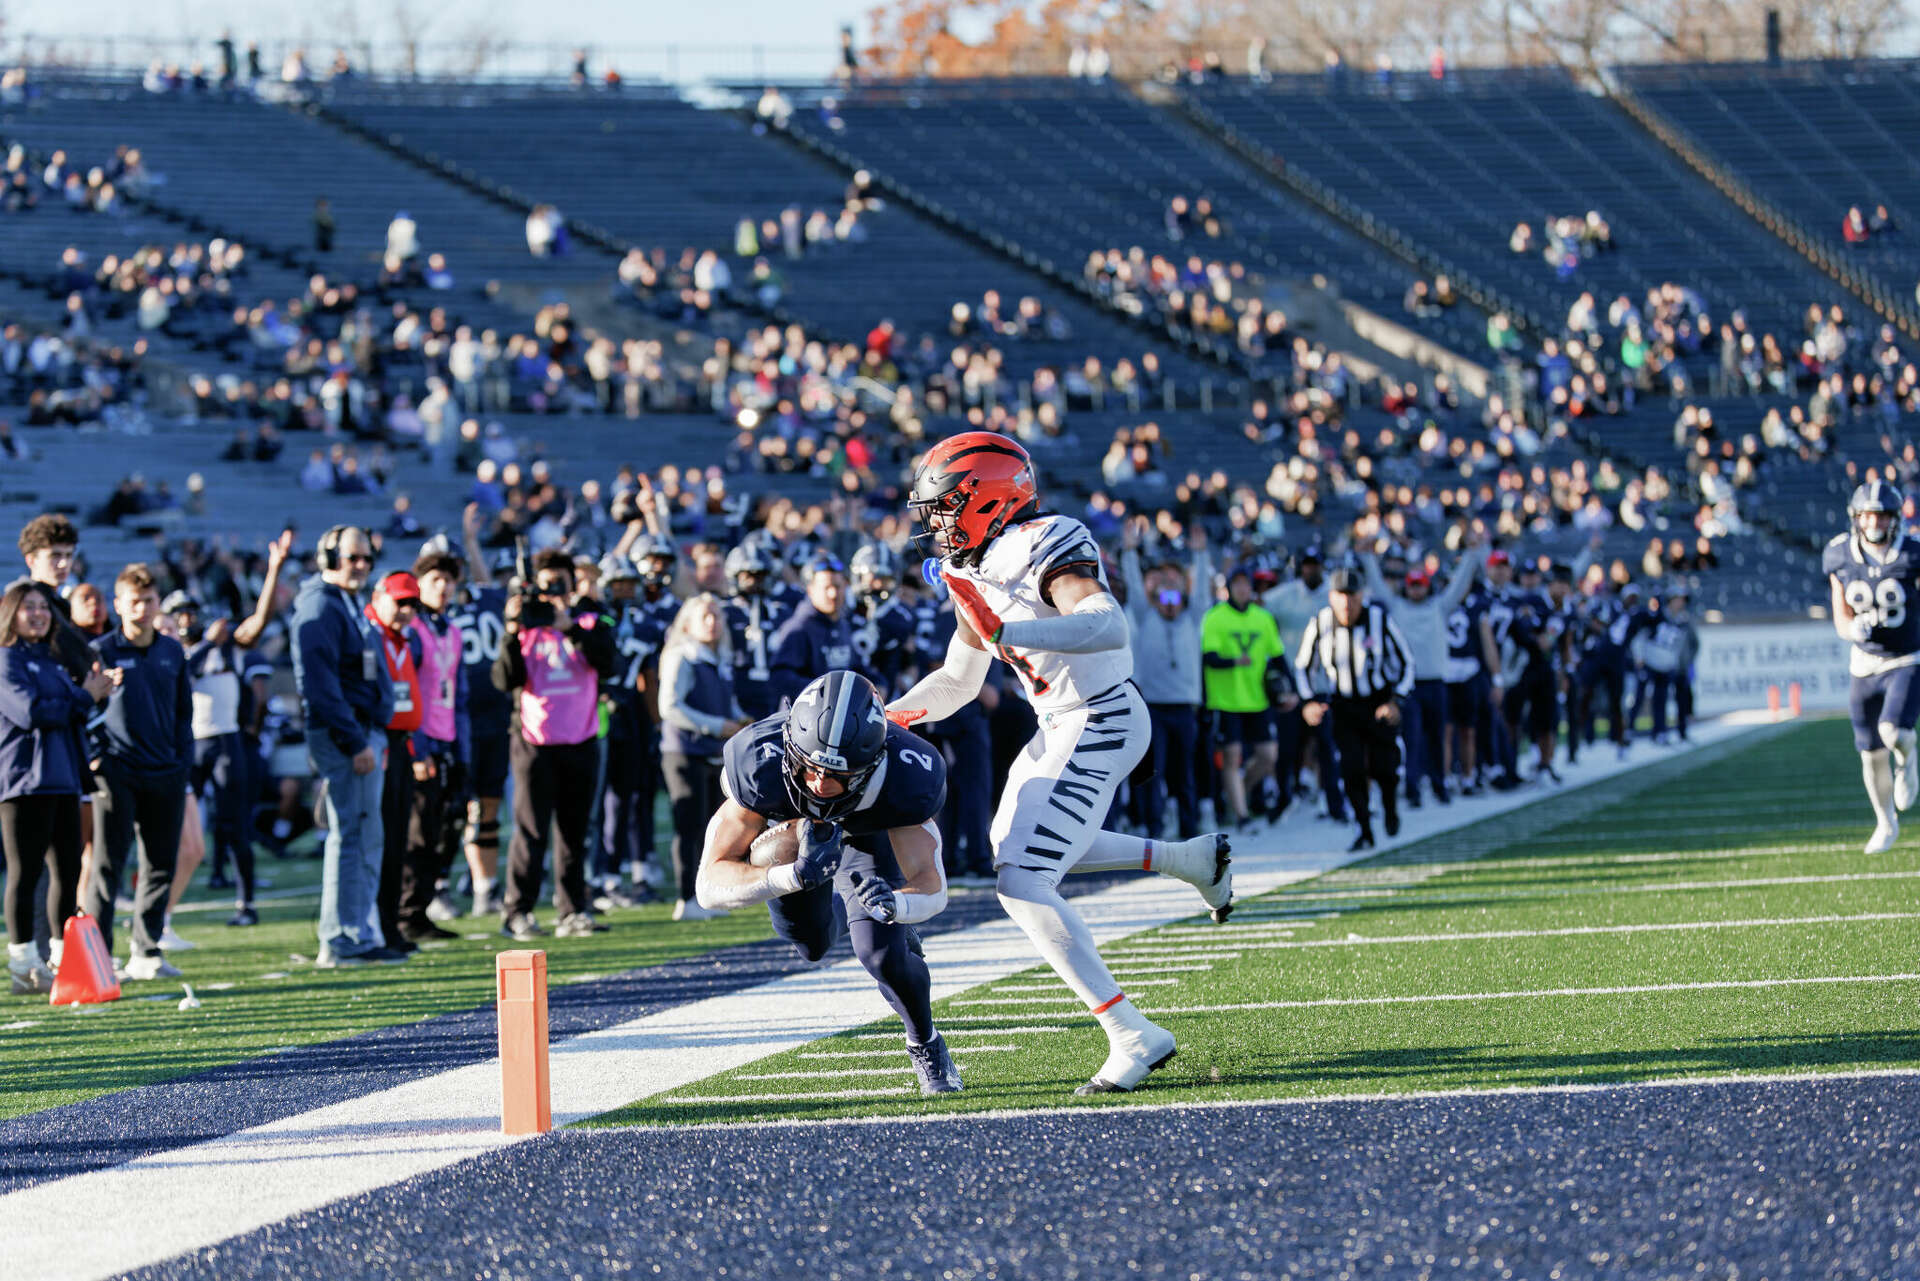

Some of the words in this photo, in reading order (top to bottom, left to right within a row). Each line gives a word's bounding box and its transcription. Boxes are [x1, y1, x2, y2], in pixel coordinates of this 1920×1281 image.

[450, 611, 505, 664] 50
[1230, 630, 1260, 656] Y
[819, 754, 843, 767] YALE
[900, 749, 933, 772] 2
